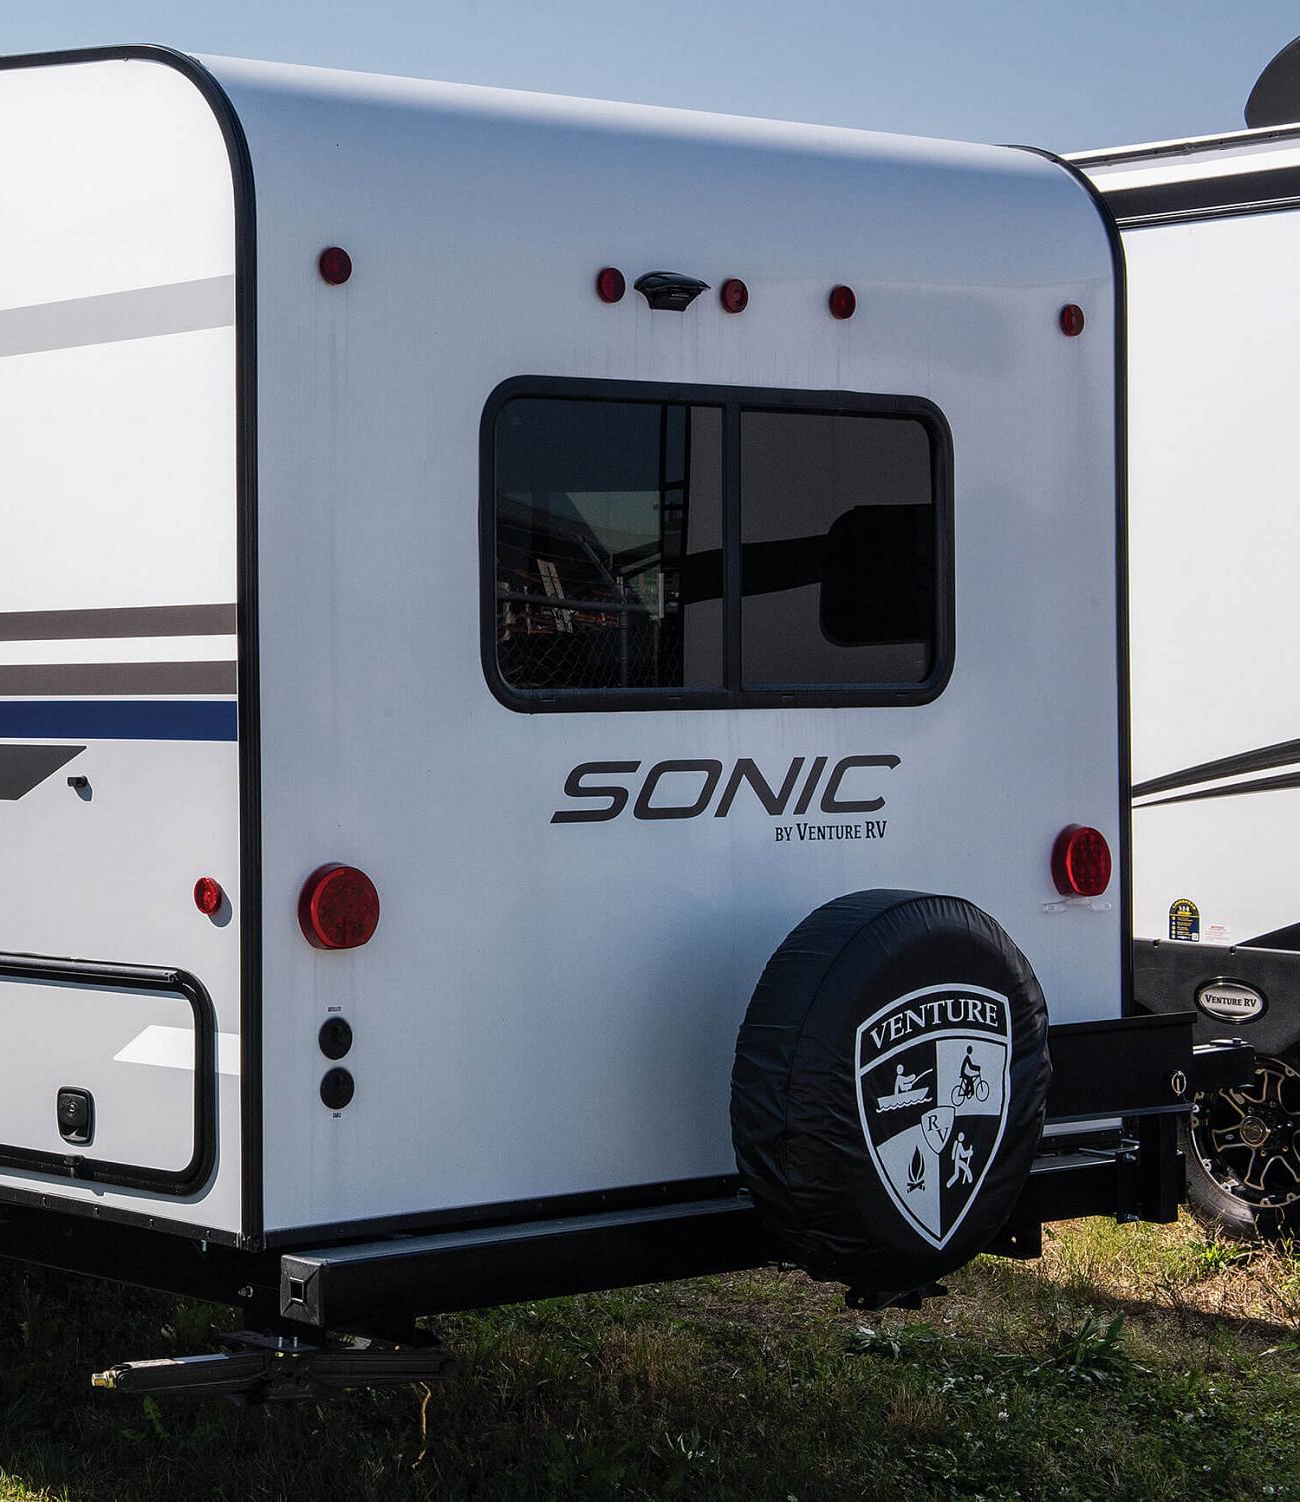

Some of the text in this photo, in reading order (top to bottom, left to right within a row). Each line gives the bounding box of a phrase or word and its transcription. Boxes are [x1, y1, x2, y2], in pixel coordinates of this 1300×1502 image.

[549, 754, 902, 824] SONIC
[864, 820, 888, 839] RV
[1243, 998, 1257, 1008] RV
[869, 998, 999, 1050] VENTURE
